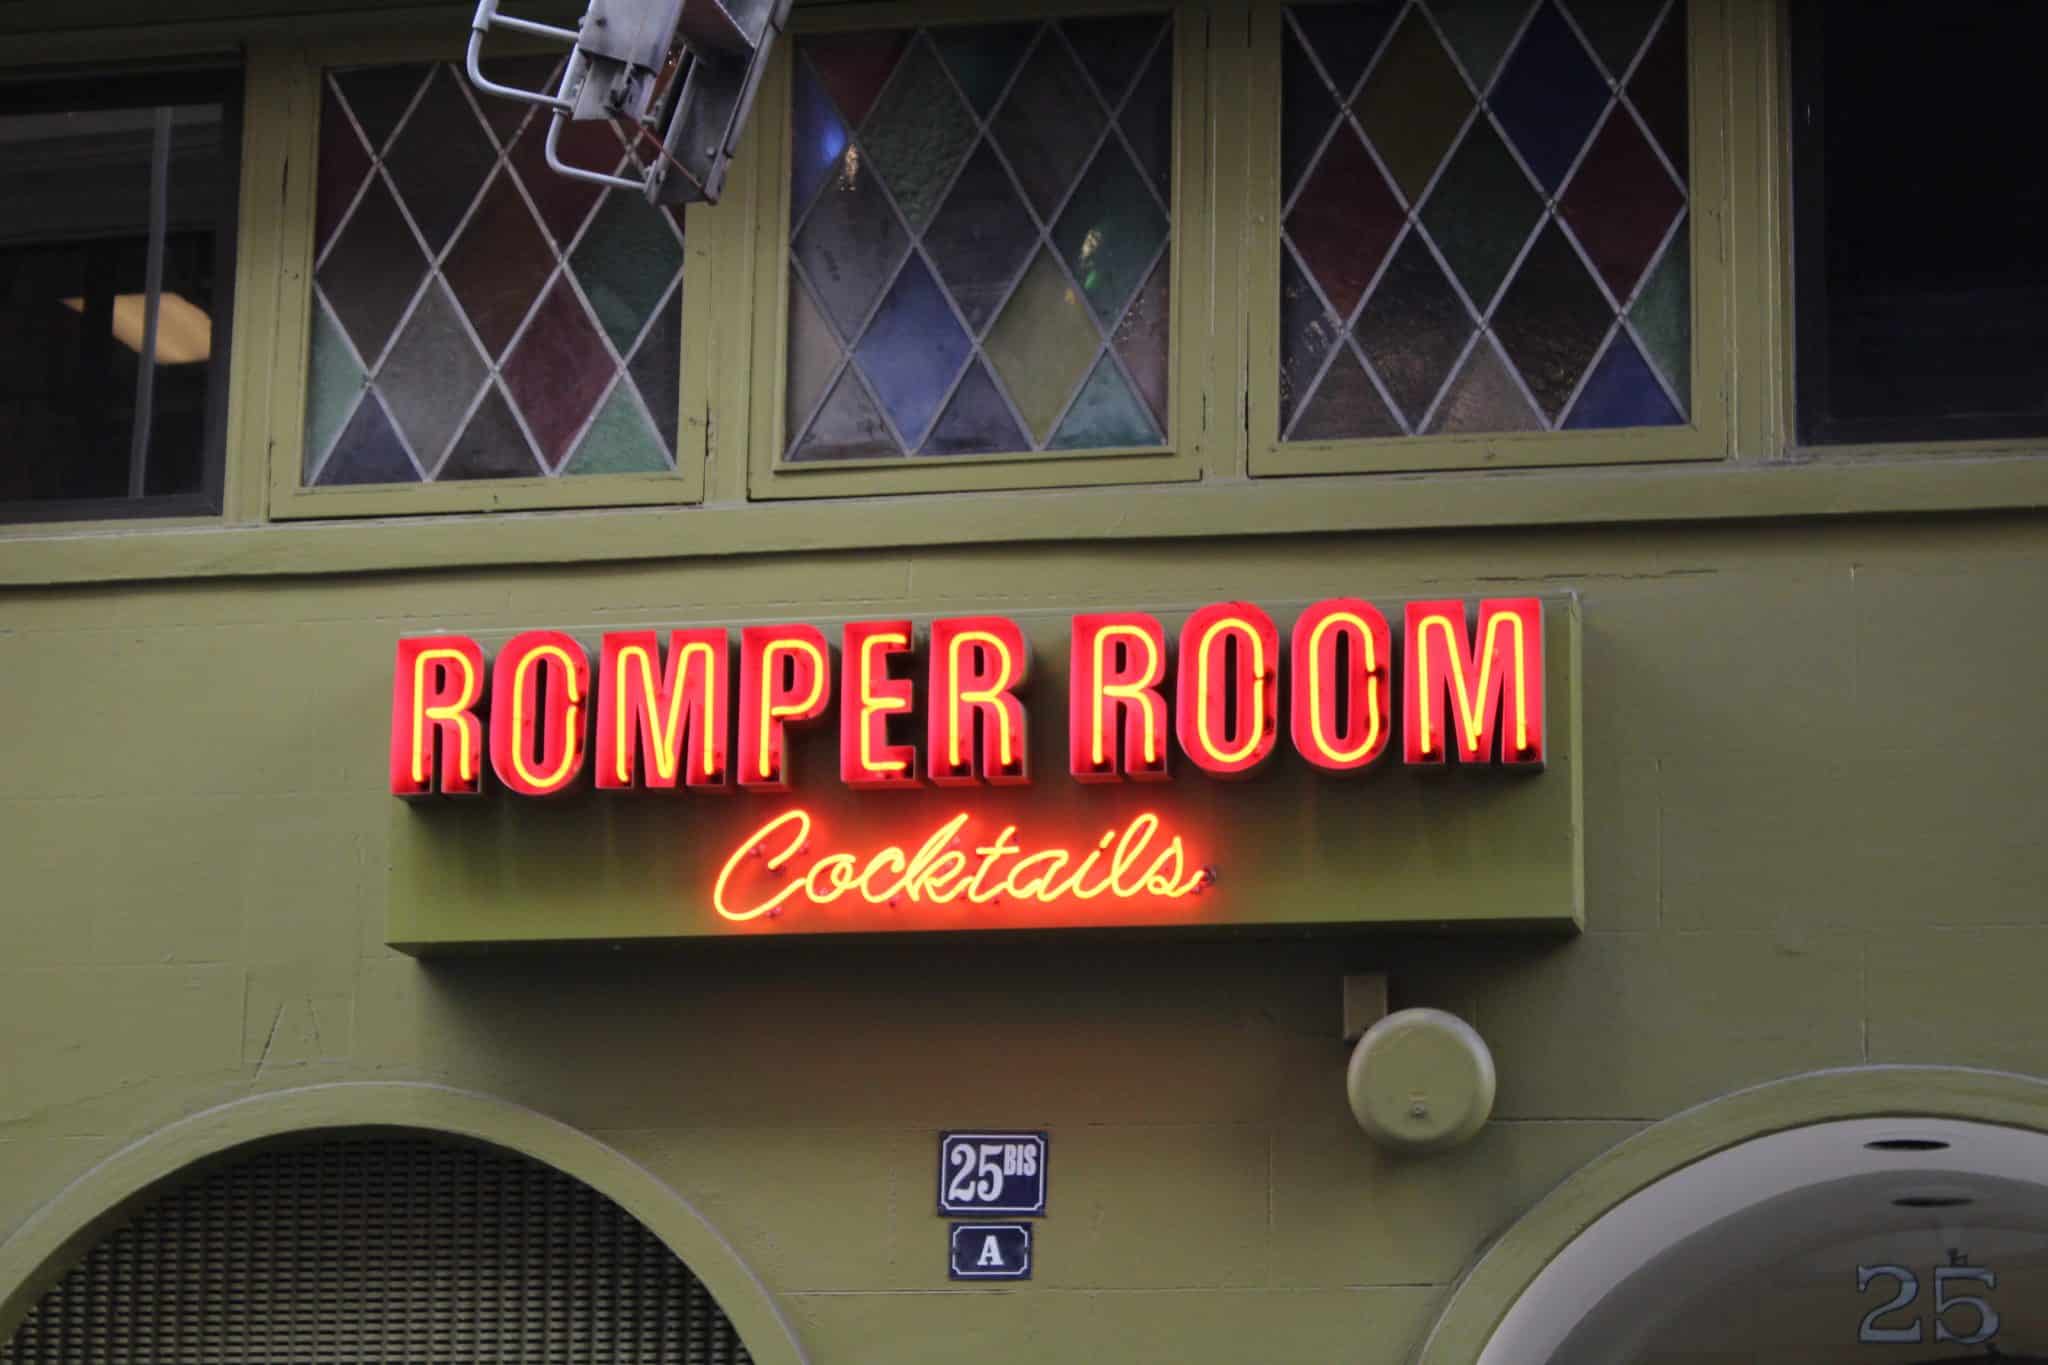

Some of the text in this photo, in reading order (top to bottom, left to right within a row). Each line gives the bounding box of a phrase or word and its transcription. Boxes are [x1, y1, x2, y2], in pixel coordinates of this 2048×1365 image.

[391, 597, 1546, 796] ROMPER ROOM
[713, 810, 1205, 921] Cocktails
[976, 1234, 1005, 1266] A
[1857, 1264, 2000, 1344] 25
